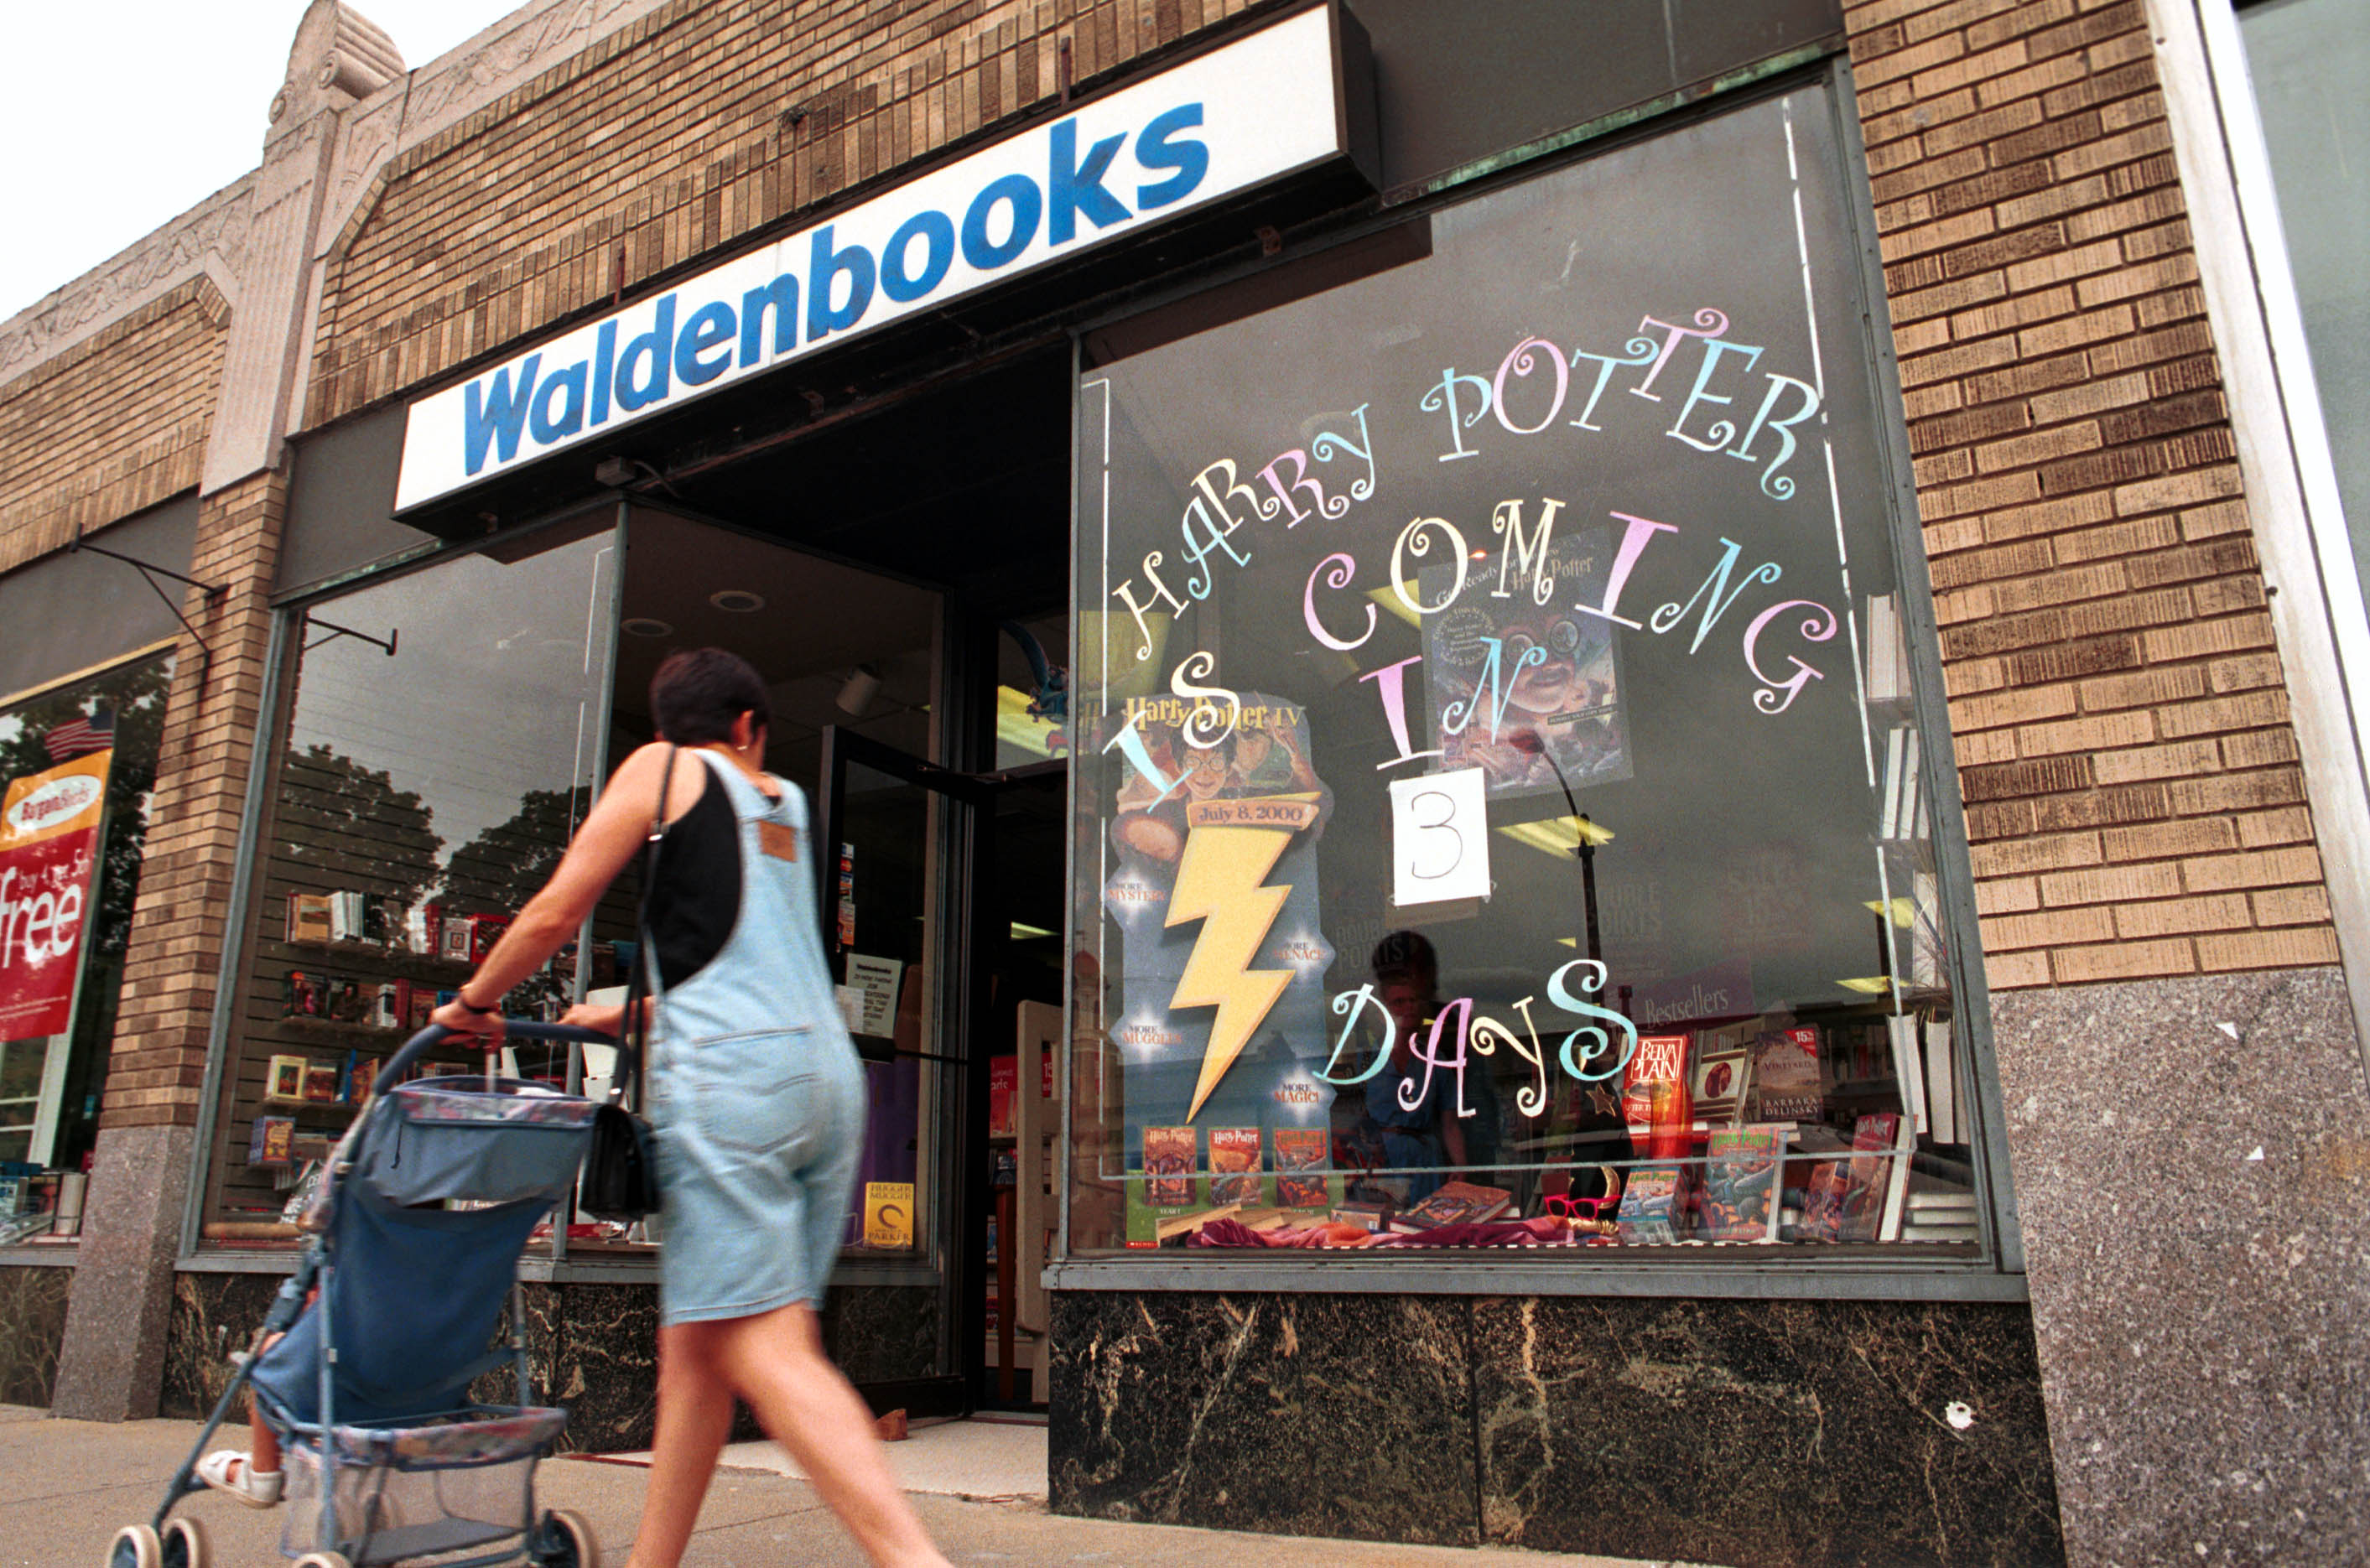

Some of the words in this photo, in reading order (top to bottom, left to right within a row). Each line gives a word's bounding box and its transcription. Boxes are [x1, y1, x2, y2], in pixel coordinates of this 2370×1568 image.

[463, 101, 1210, 476] Waldenbooks
[1112, 402, 1376, 661] HARRY
[1420, 307, 1821, 501] POTTER
[1102, 651, 1240, 813] IS
[1302, 497, 1837, 714] COMING
[1359, 636, 1547, 771] IN
[1198, 806, 1234, 823] July
[1255, 805, 1303, 821] 2000
[1411, 791, 1463, 880] 3
[0, 866, 82, 968] free
[1645, 983, 1728, 1030] Bestsellers
[1312, 958, 1638, 1119] DAYS
[1640, 1040, 1677, 1061] BELVA
[1283, 1083, 1311, 1092] MORE
[1634, 1058, 1676, 1080] PLAIN
[1765, 1096, 1818, 1107] BARBARA
[1765, 1106, 1819, 1116] DELINSKY
[1214, 1132, 1234, 1145] Harry
[1234, 1129, 1258, 1144] Potter
